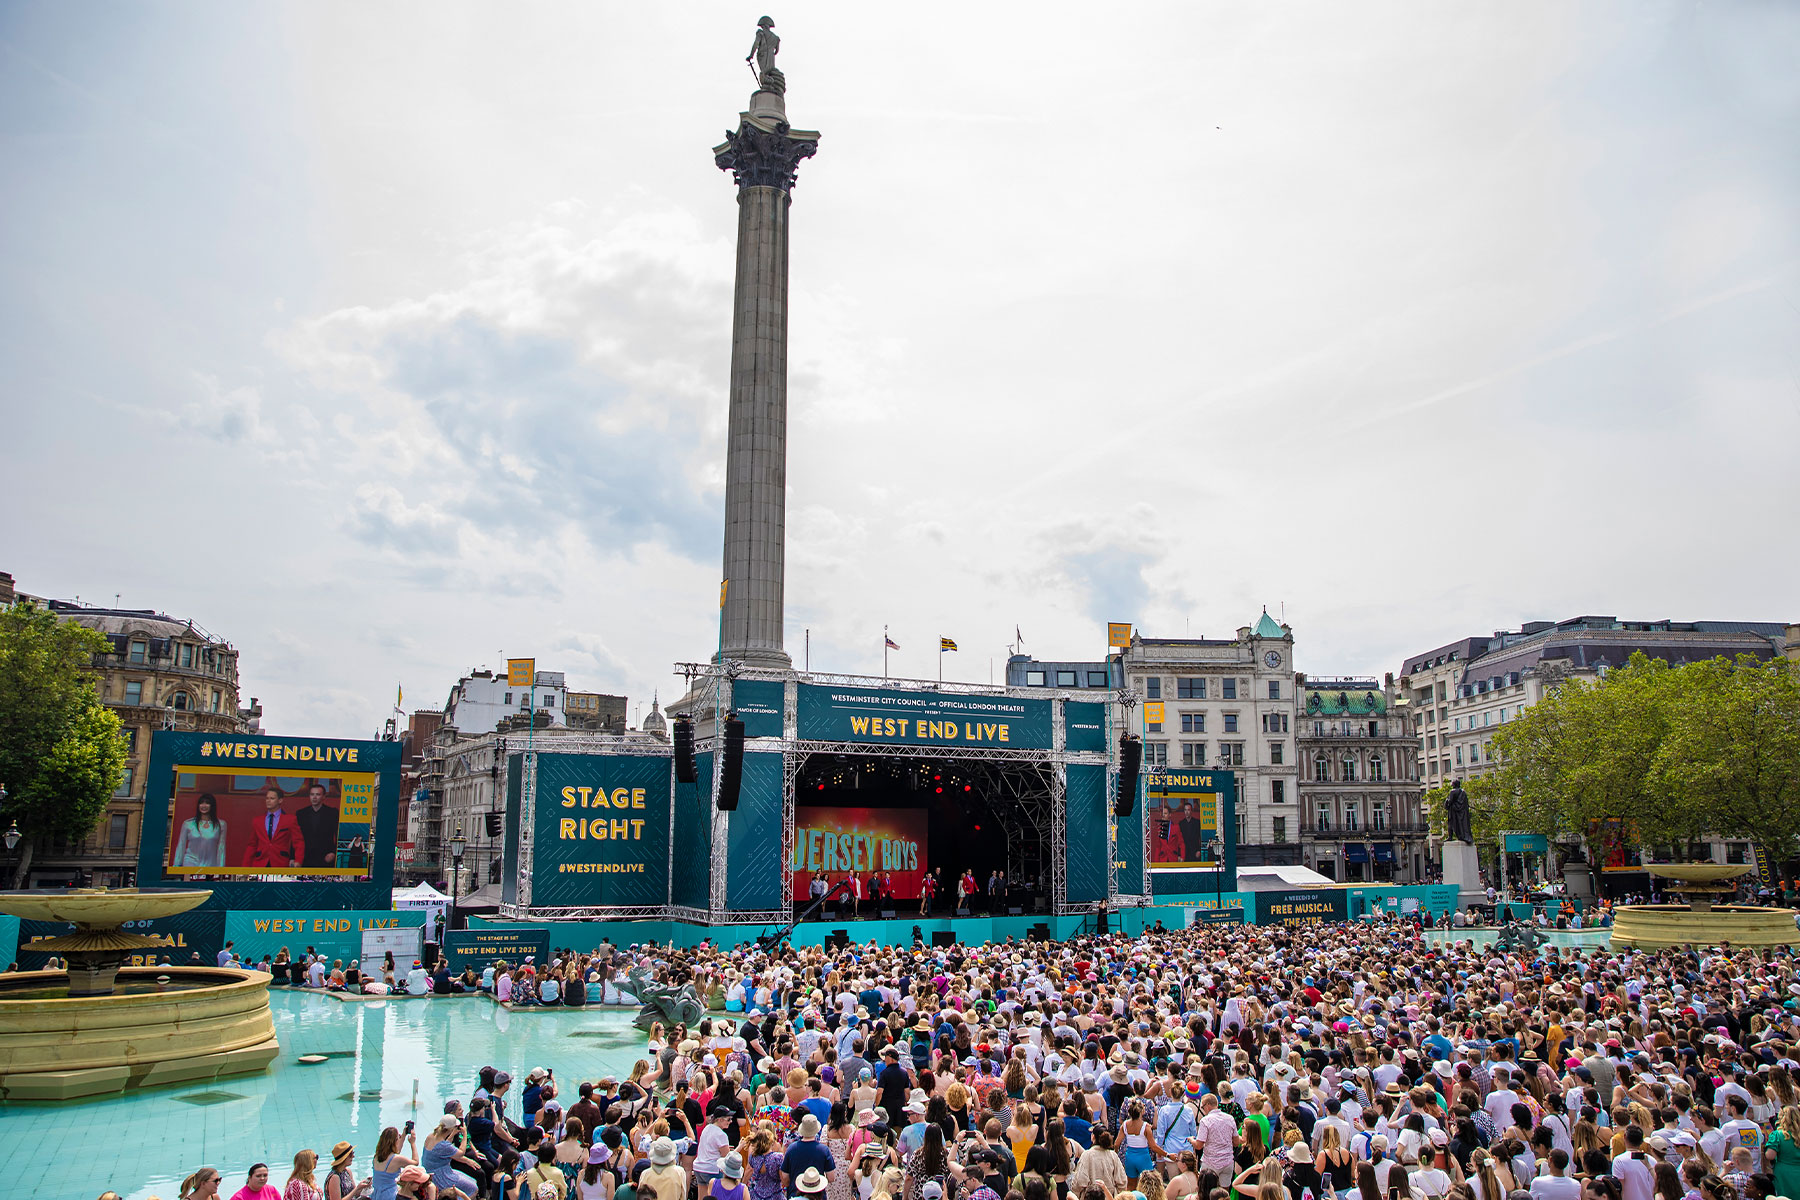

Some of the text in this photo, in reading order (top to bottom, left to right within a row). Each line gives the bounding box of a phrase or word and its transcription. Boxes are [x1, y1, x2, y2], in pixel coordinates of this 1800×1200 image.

[831, 694, 880, 704] WESTMINSTER
[898, 698, 926, 706] COUNCIL
[938, 700, 968, 709] OFFICIAL
[968, 702, 996, 710] LONDON
[998, 704, 1024, 712] THEATRE
[850, 716, 1010, 742] WEST END LIVE
[201, 741, 358, 763] #WESTENDLIVE
[1148, 774, 1212, 787] ESTENDLIVE
[343, 784, 372, 793] WEST
[346, 796, 368, 804] END
[562, 786, 646, 810] STAGE
[344, 806, 368, 816] LIVE
[560, 818, 646, 840] RIGHT
[790, 828, 918, 872] JERSEY BOYS
[559, 864, 644, 873] #WESTENDLIVE
[1755, 846, 1770, 882] COFFEE
[1221, 898, 1242, 908] LIVE
[1270, 902, 1334, 914] FREE MUSICAL
[138, 920, 154, 928] OF
[254, 918, 400, 933] WEST END LIVE
